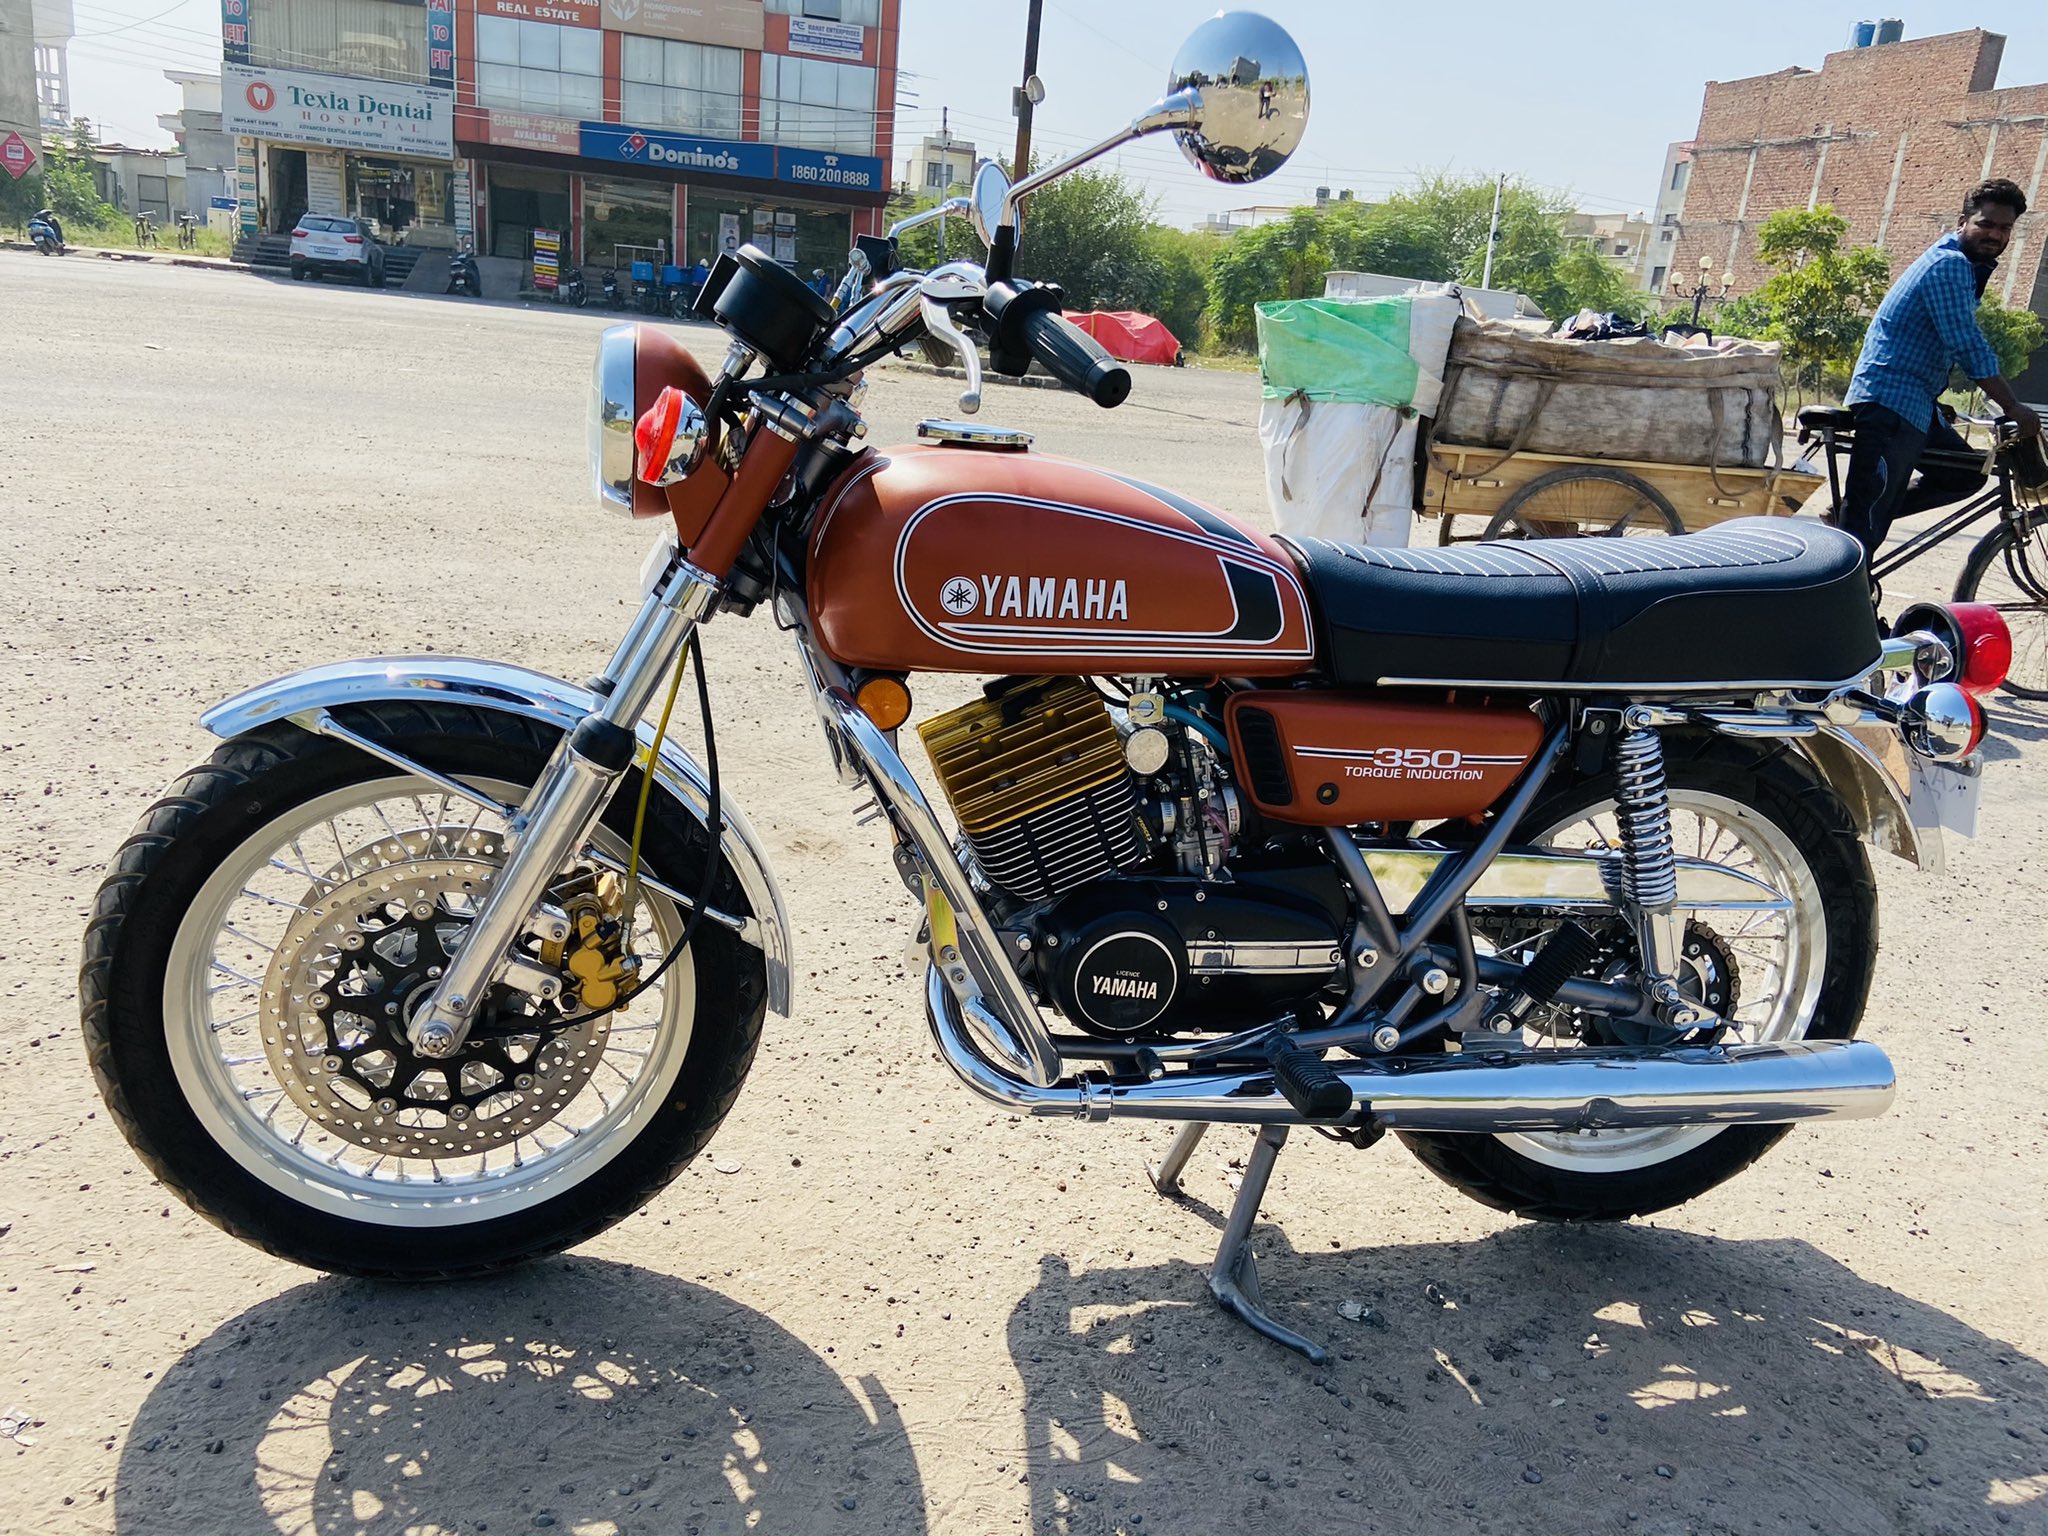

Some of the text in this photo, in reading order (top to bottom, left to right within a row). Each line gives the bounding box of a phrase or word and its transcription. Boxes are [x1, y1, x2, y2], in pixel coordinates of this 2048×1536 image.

[497, 2, 580, 21] REAL ESTATE
[643, 11, 668, 21] CLINIC
[224, 23, 246, 45] FIT
[432, 24, 449, 41] TO
[431, 48, 451, 70] FIT
[358, 94, 432, 121] Dental
[513, 129, 557, 142] AVAILABLE
[540, 120, 578, 135] SPACE
[649, 143, 739, 170] Domino's
[791, 164, 870, 186] 1860 200 8888
[981, 574, 1128, 620] YAMAHA
[1373, 747, 1461, 769] 350
[1344, 766, 1484, 780] TORQUE INDUCTION
[1116, 970, 1141, 978] LICENCE
[1092, 975, 1157, 999] YAMAHA
